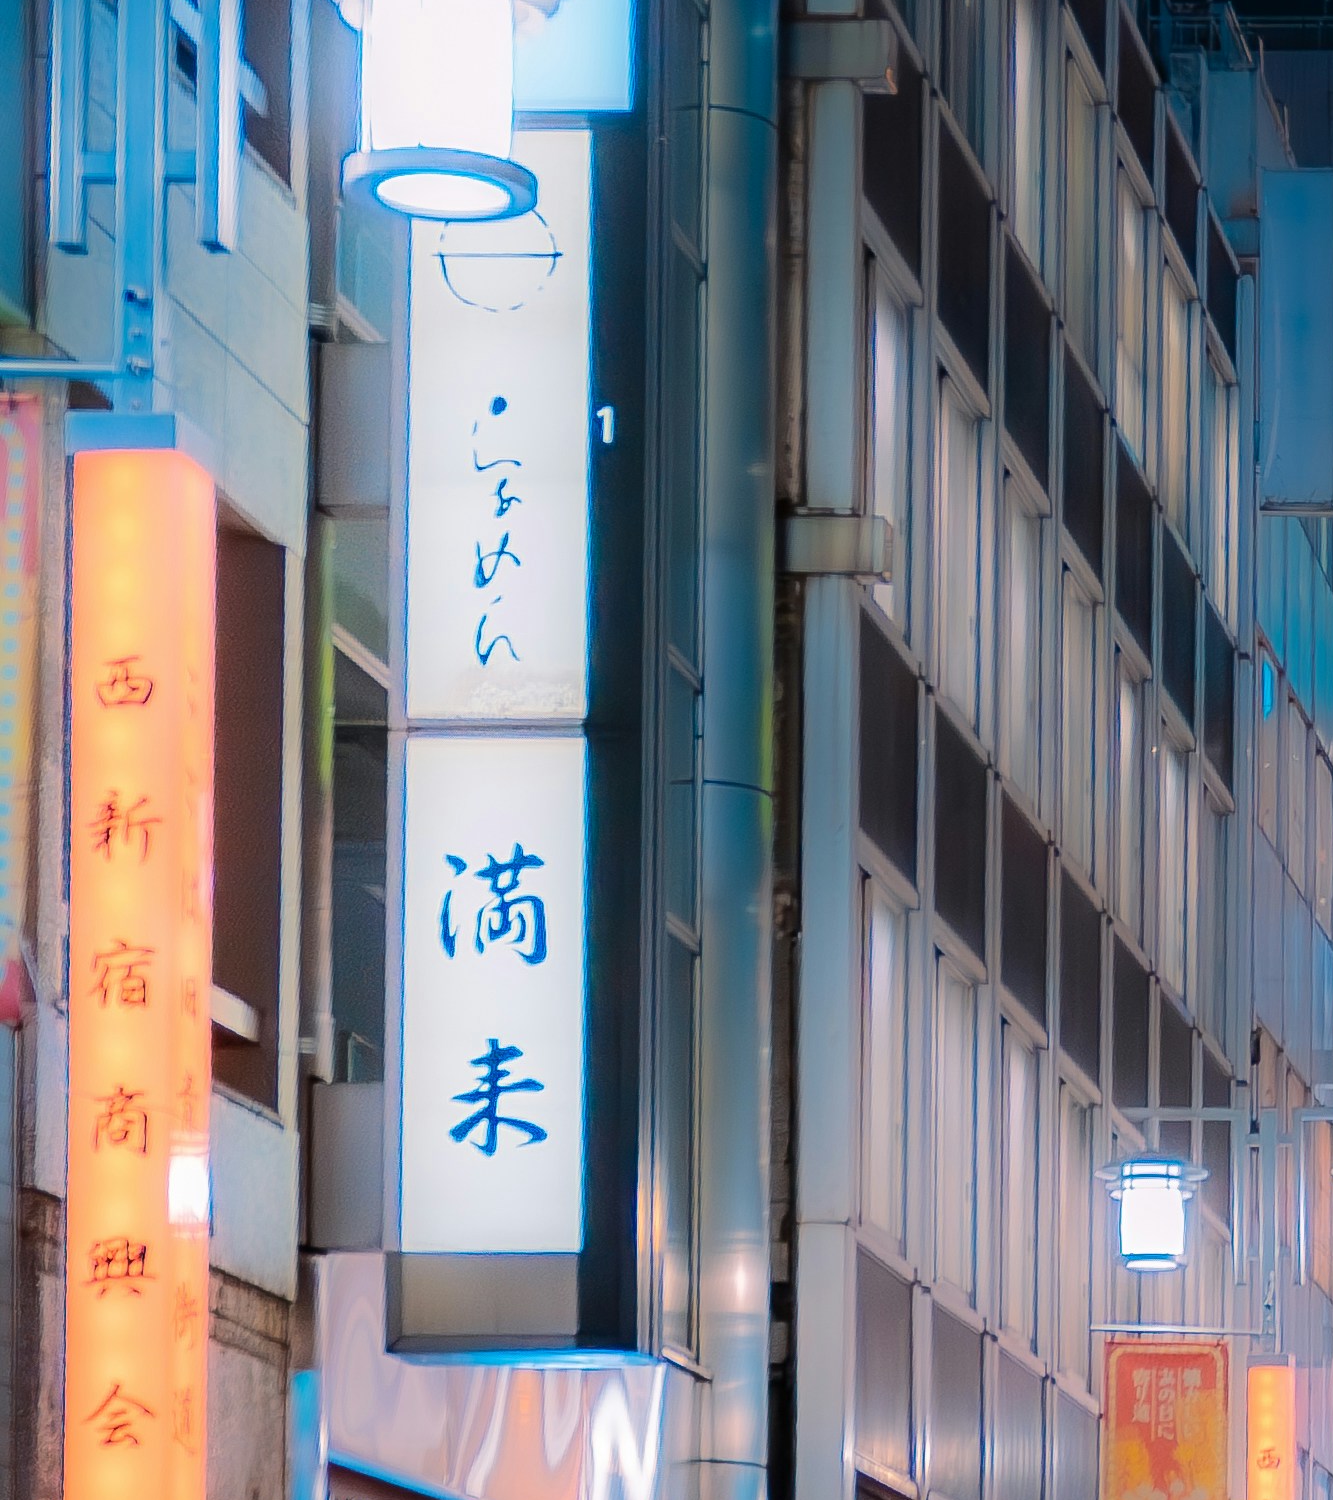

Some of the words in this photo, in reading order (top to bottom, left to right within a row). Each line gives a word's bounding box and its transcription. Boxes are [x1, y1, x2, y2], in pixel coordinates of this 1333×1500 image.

[597, 406, 613, 444] 1
[82, 655, 162, 1446] 西新宿商興会
[440, 843, 548, 1157] 満来
